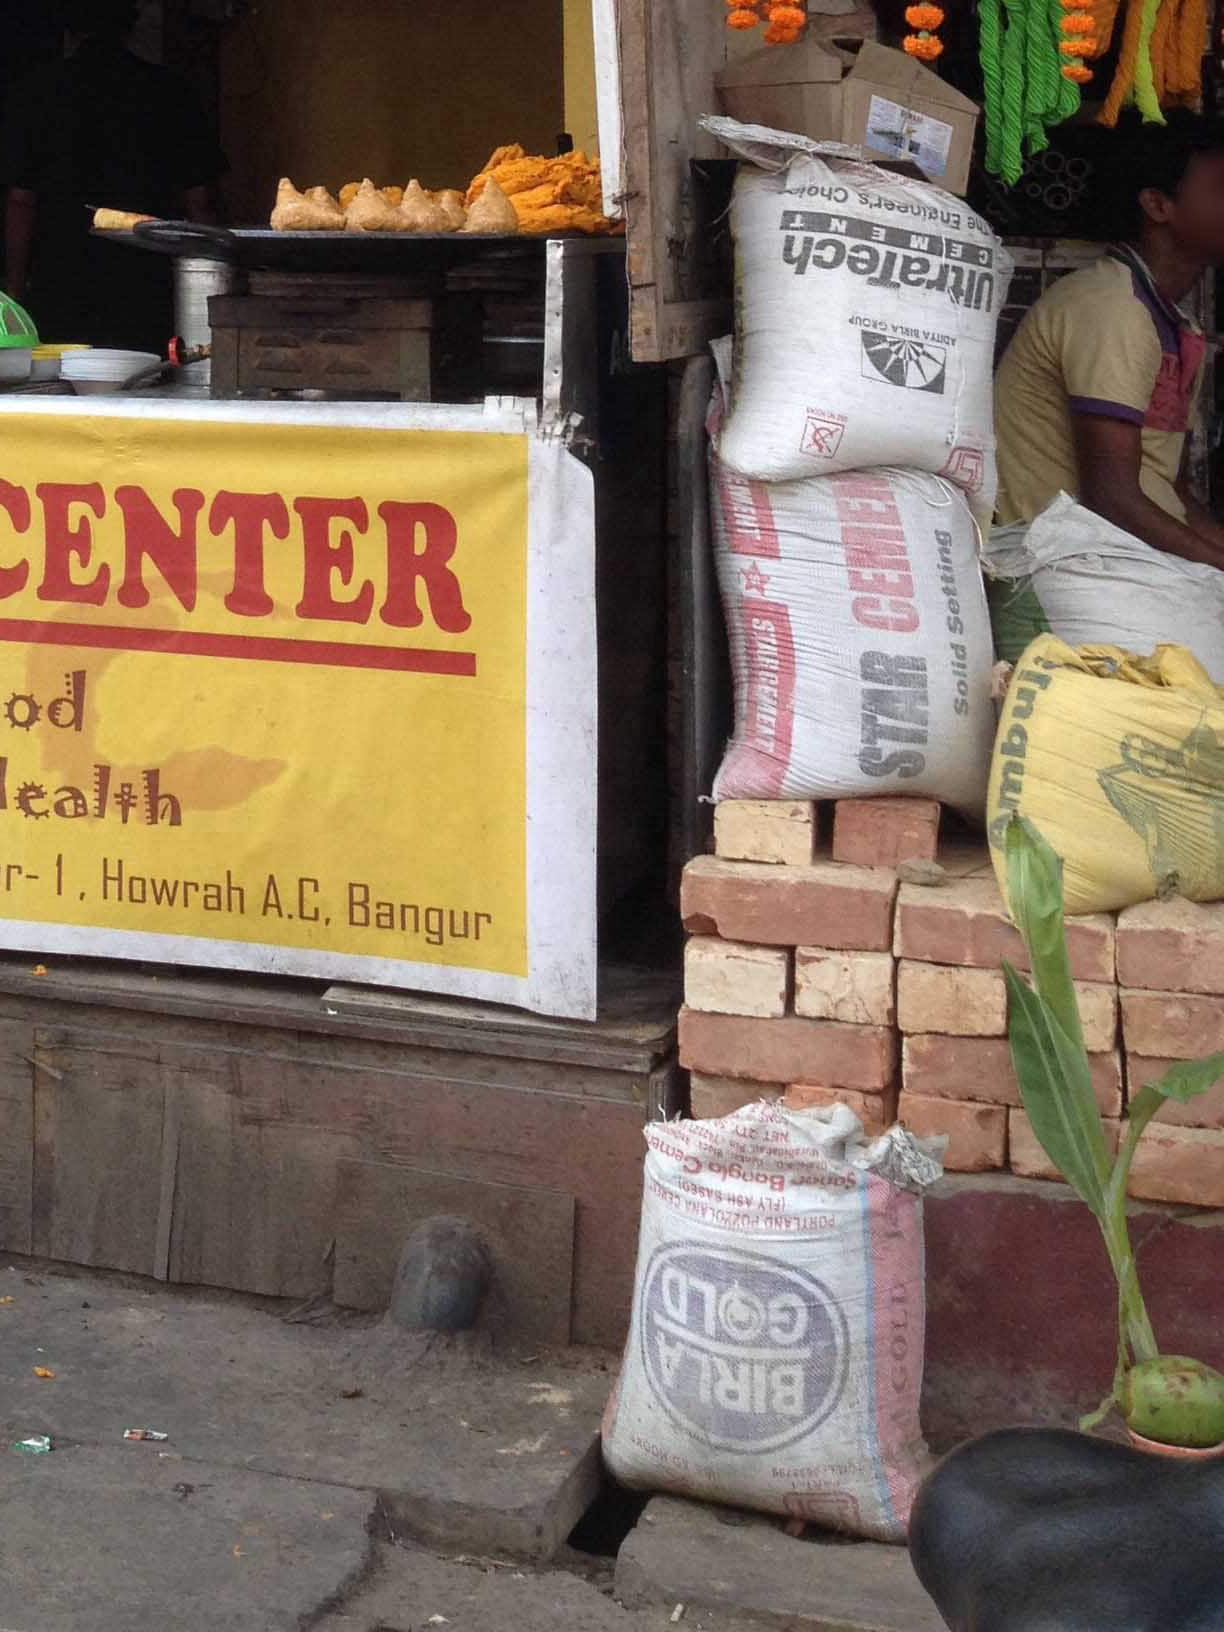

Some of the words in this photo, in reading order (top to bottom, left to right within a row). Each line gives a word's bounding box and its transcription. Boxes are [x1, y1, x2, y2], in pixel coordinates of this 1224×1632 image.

[789, 214, 989, 265] CEMENT
[858, 191, 962, 230] Engineer's
[782, 234, 994, 313] UltraTech
[934, 529, 964, 636] Setting
[860, 650, 928, 778] STAR
[950, 643, 969, 716] Solid
[102, 857, 245, 916] Howrah
[348, 882, 492, 947] Bangur
[707, 1161, 786, 1193] Bangla
[762, 1213, 836, 1232] PORTLAND
[661, 1268, 808, 1346] GOLD
[655, 1331, 806, 1416] BIRLA
